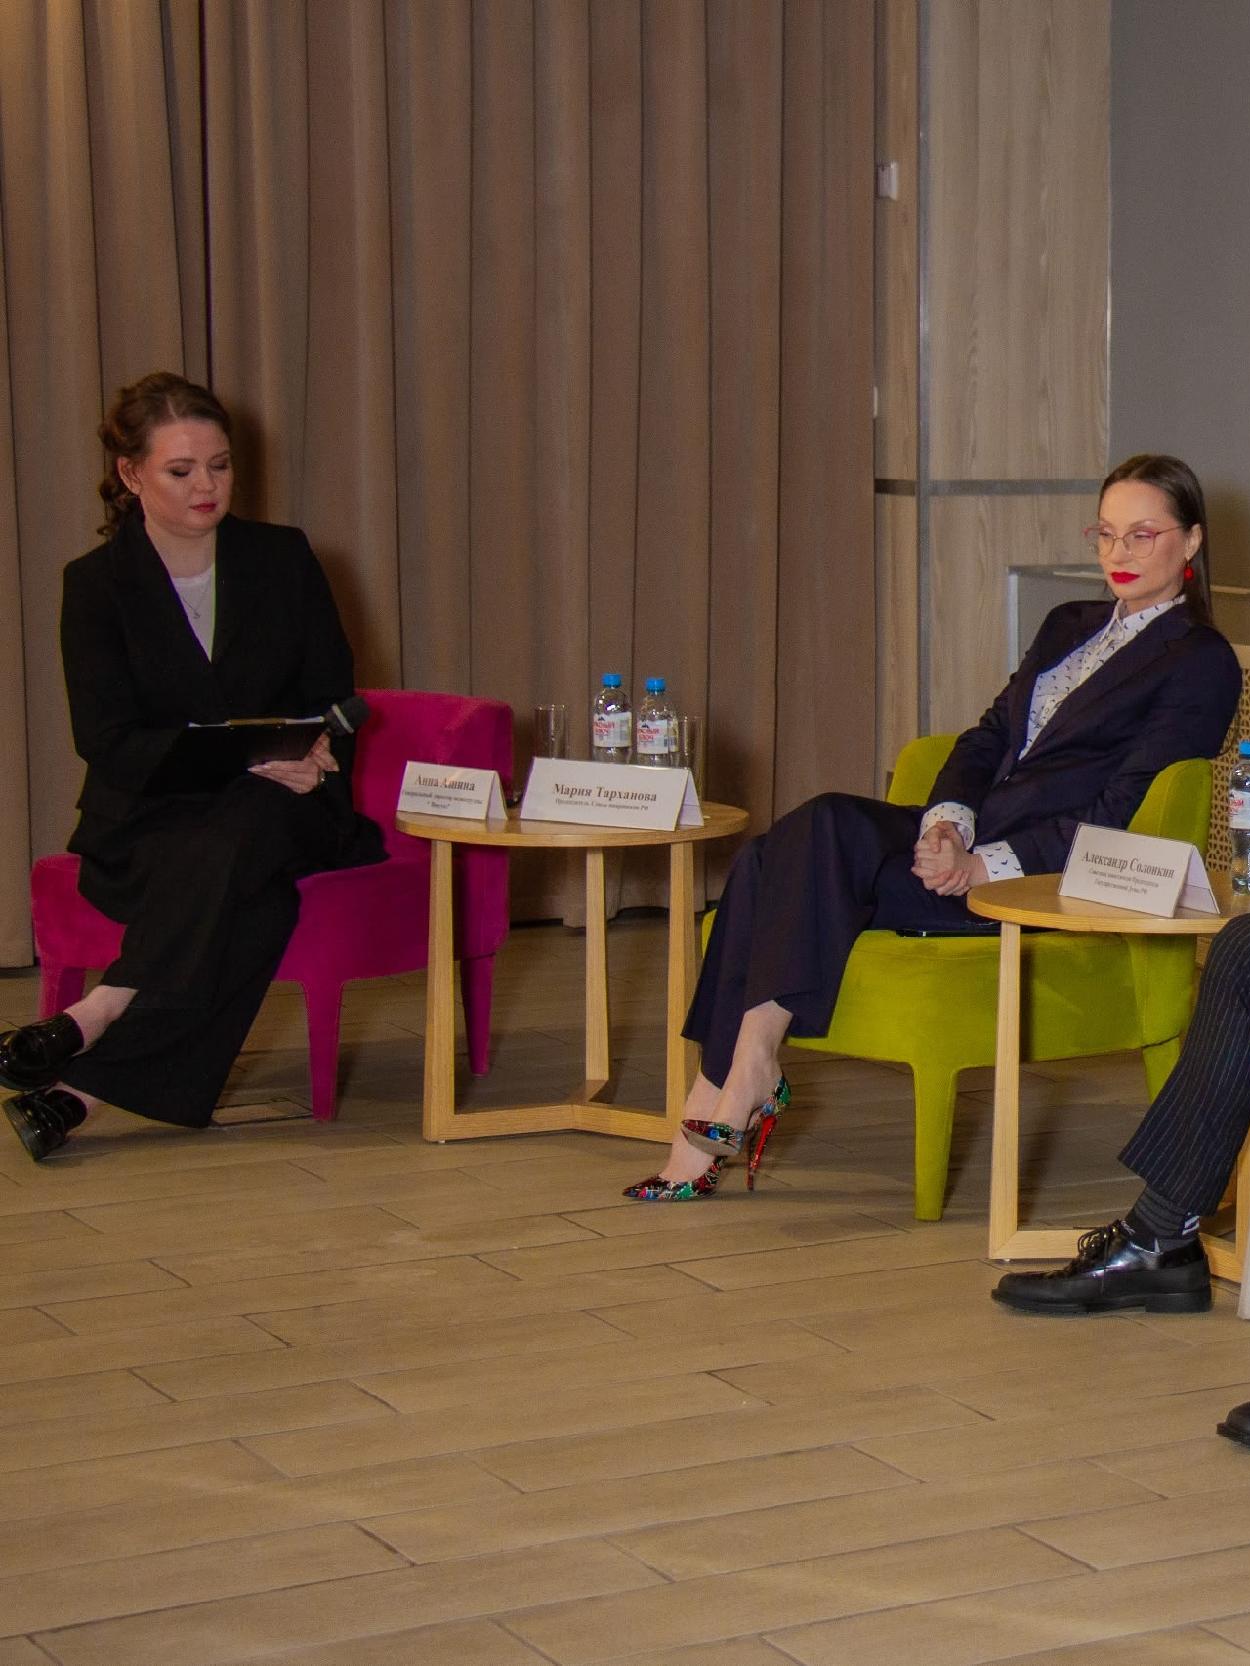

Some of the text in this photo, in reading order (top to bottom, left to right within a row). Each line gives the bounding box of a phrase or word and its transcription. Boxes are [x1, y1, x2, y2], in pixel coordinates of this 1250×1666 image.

[554, 783, 657, 801] Мария Тарханова
[1081, 852, 1128, 873] Александр
